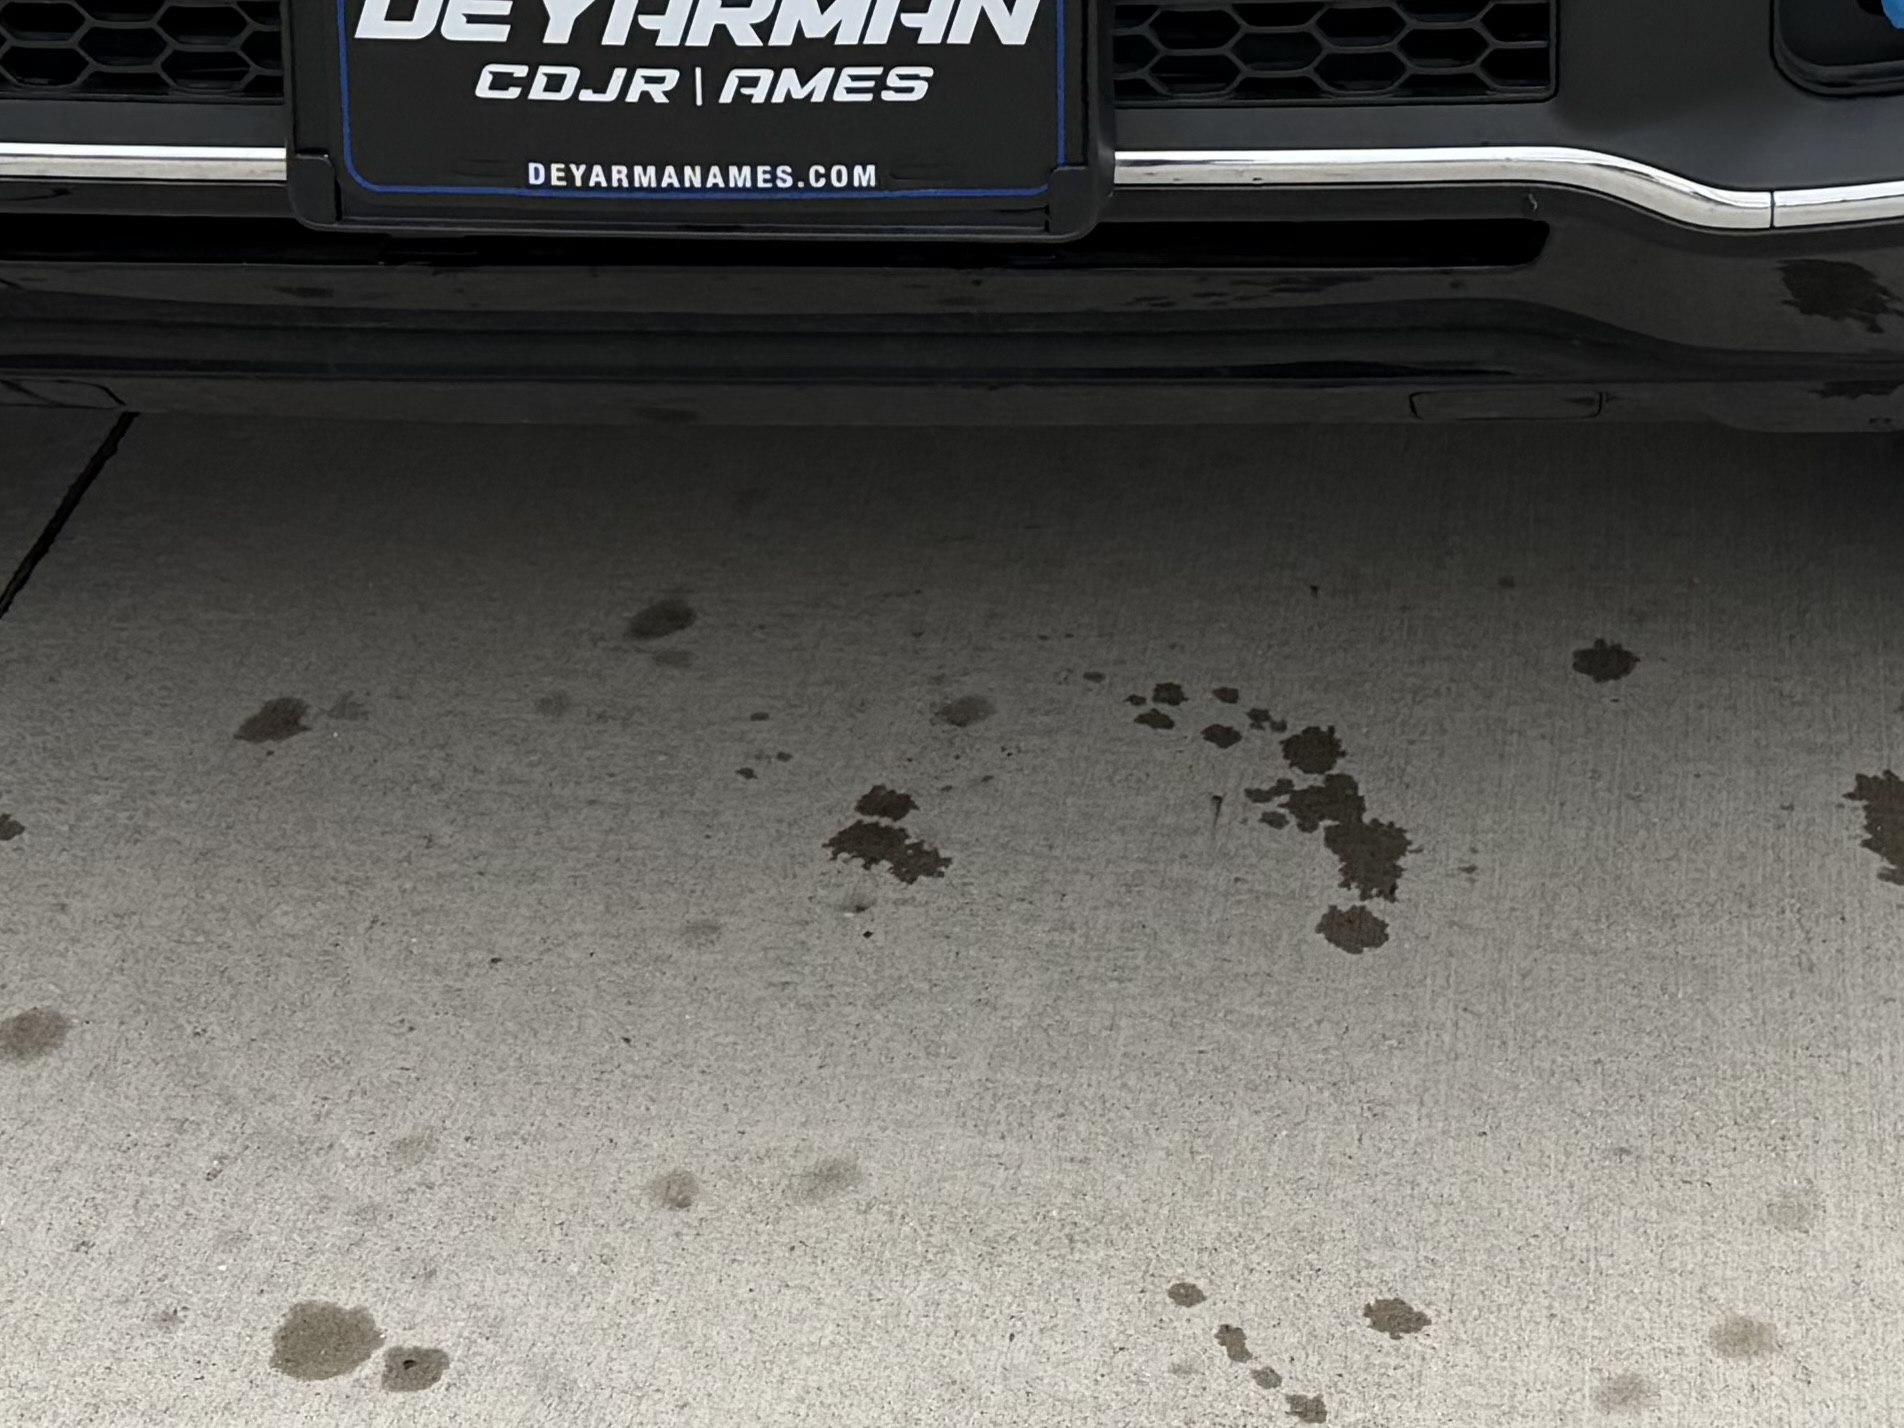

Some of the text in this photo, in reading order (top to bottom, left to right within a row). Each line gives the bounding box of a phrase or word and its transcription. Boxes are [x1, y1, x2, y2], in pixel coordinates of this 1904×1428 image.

[474, 63, 680, 104] CDJR
[718, 66, 934, 104] AMES
[527, 161, 878, 189] DEYARMANAMES.COM
